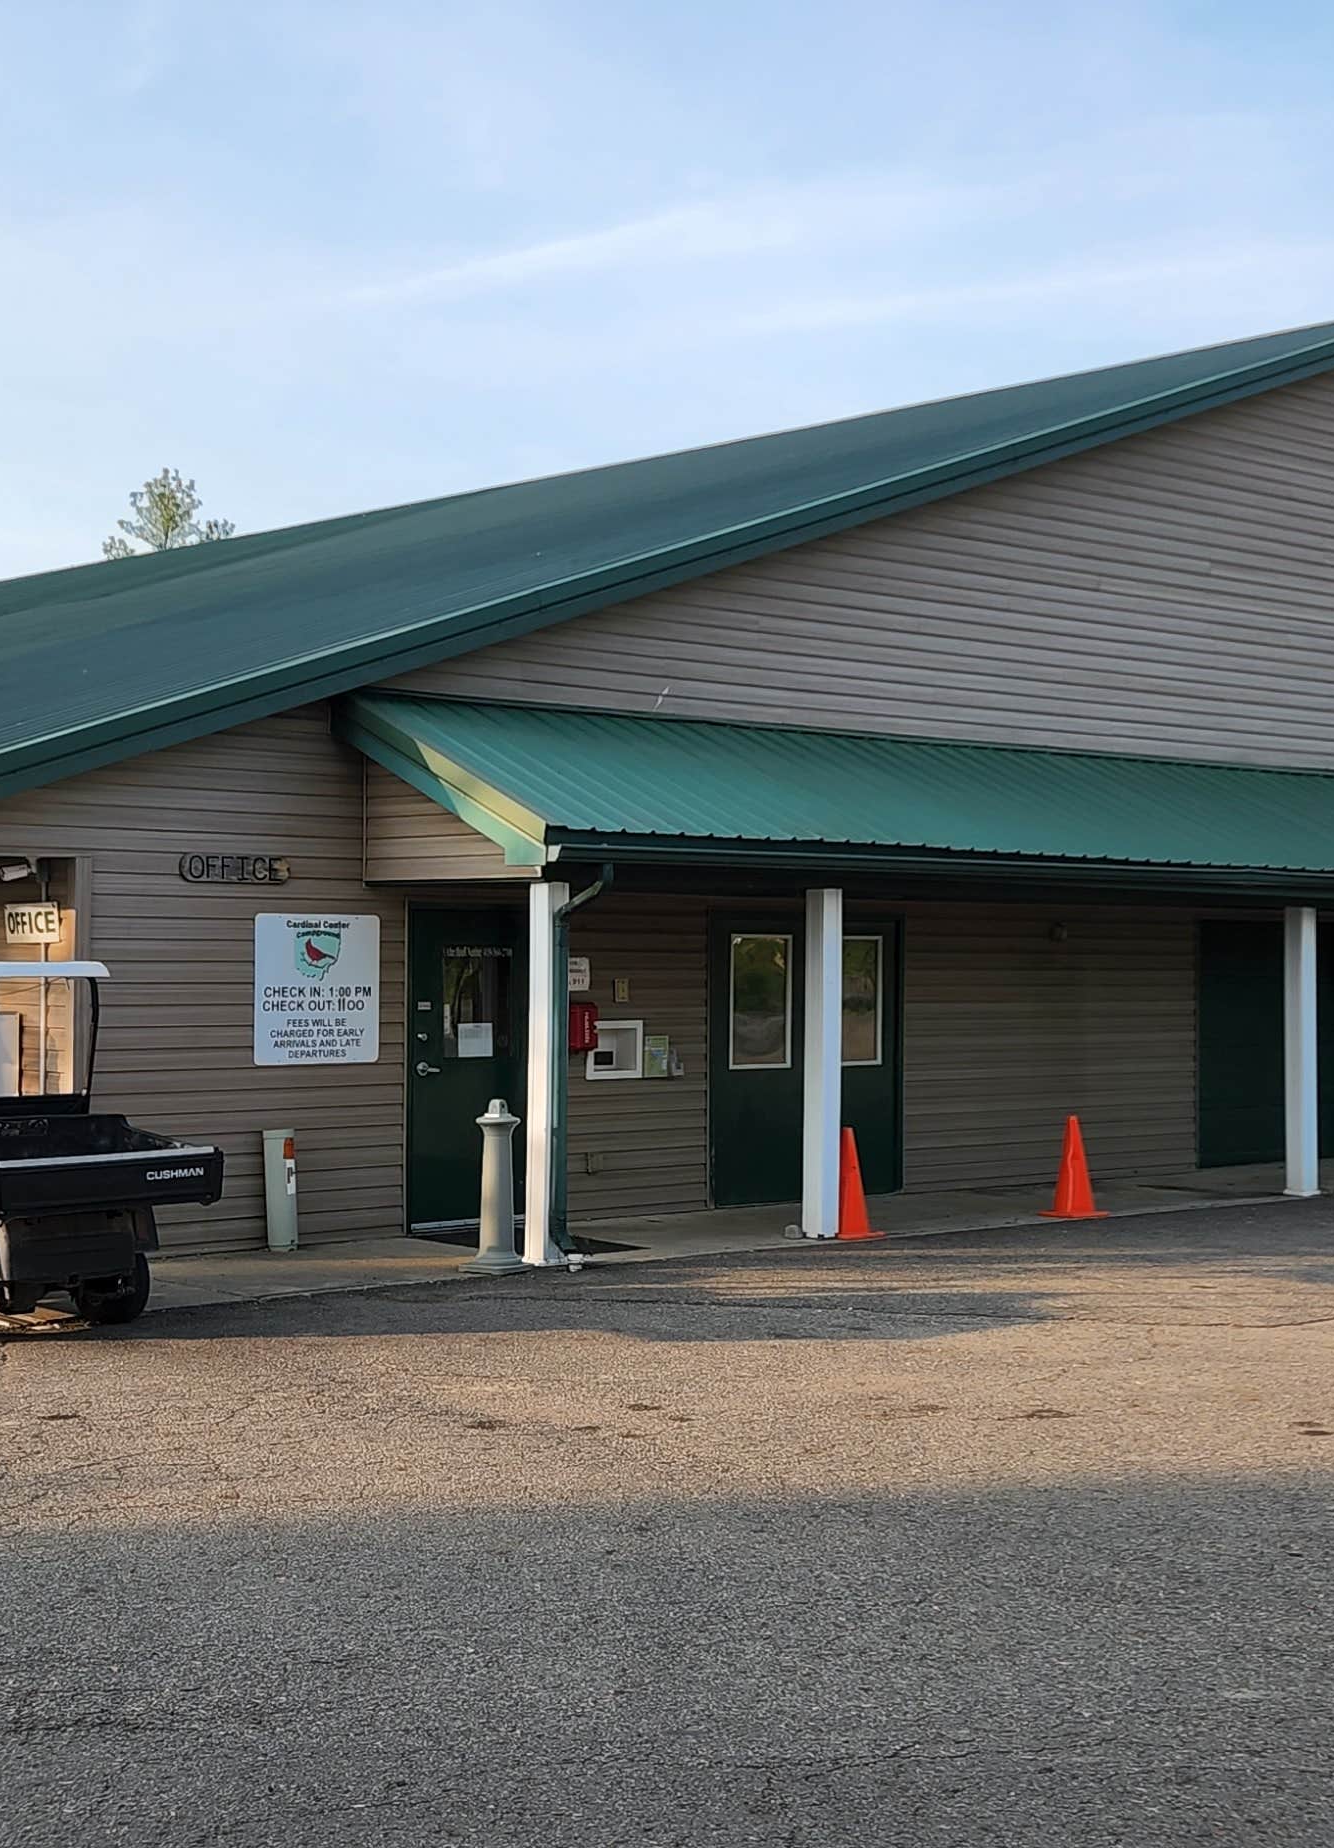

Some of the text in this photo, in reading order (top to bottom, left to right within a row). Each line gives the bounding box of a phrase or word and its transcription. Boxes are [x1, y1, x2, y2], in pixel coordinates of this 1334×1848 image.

[189, 855, 283, 881] OFFICE
[7, 911, 56, 934] OFFICE
[286, 920, 350, 929] Cardinal Center
[263, 986, 372, 998] CHECK IN: 1:00 PM
[262, 1000, 304, 1012] CHECK
[308, 1000, 336, 1012] OUT:
[287, 1018, 347, 1028] FEES WILL BE
[269, 1028, 365, 1038] CHARGED FOR EARLY
[273, 1039, 362, 1048] ARRIVALS AND LATE
[288, 1049, 347, 1058] DEPARTURES
[146, 1167, 204, 1180] CUSHMAN
